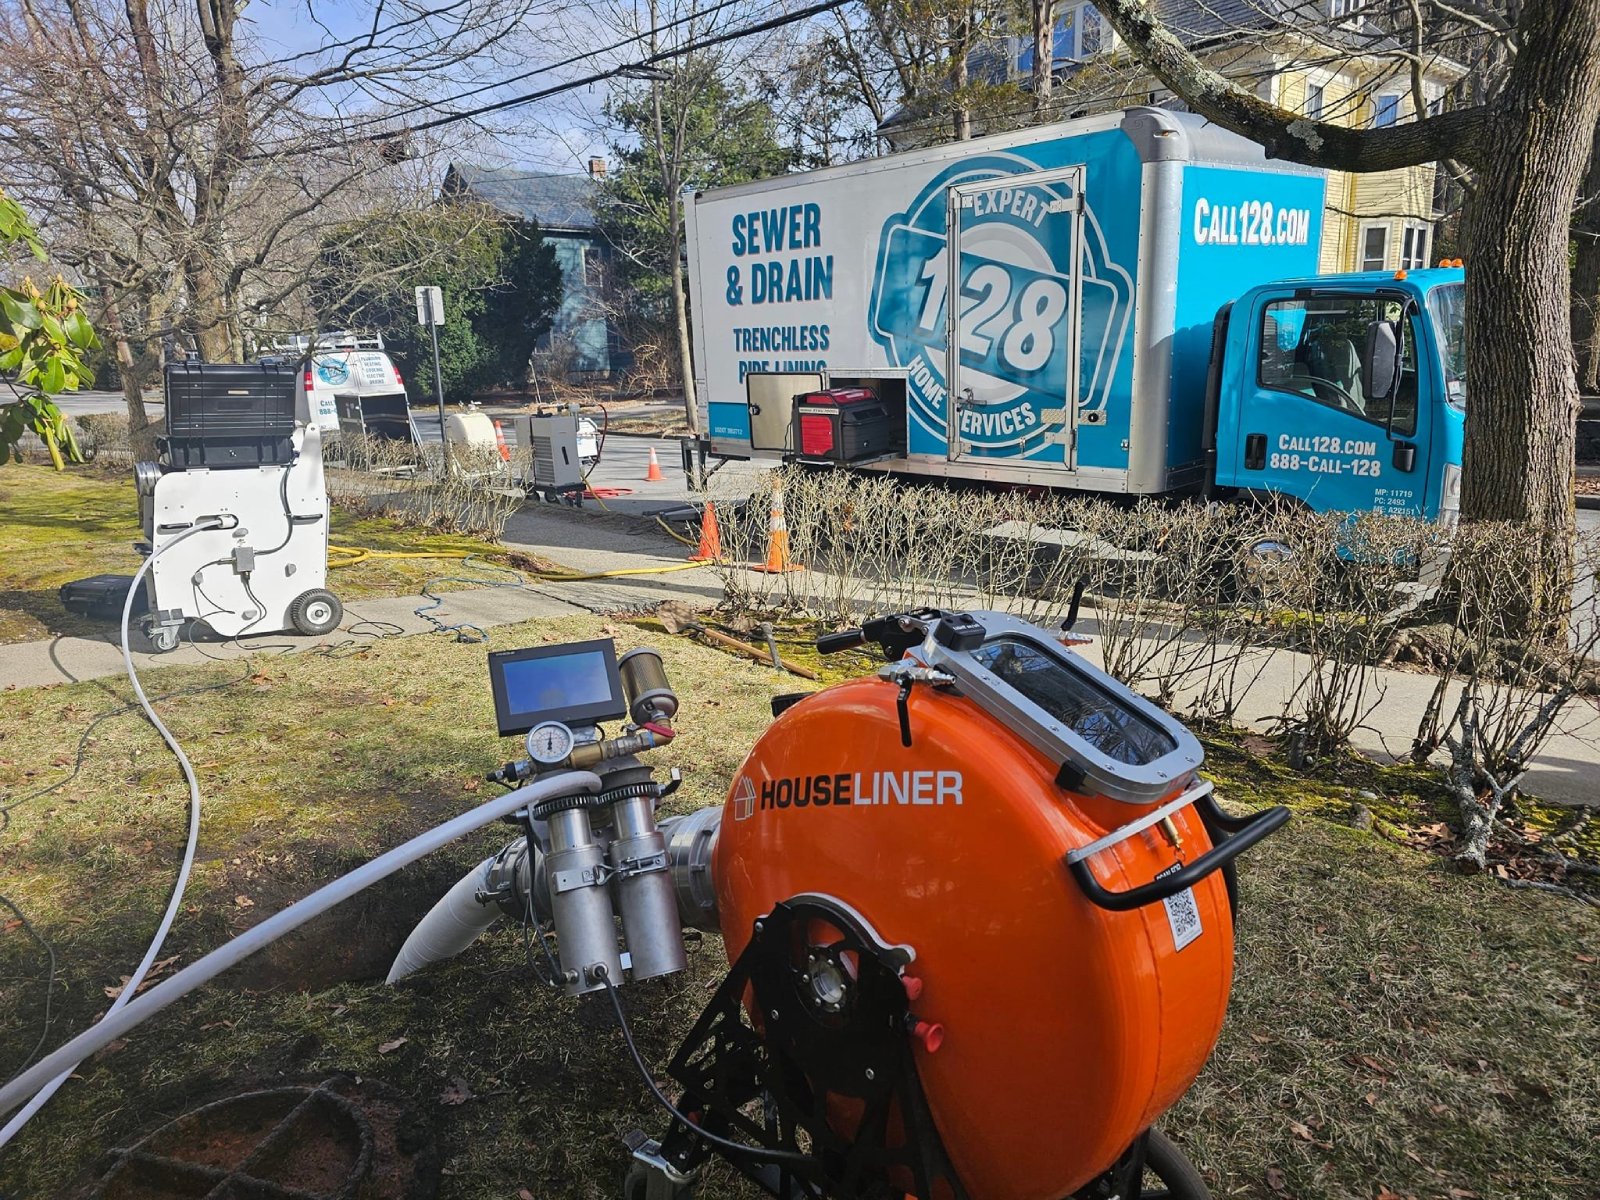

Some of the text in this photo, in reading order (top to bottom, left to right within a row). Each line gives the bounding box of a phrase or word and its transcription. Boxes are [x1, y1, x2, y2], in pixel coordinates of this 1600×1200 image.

[973, 188, 1051, 228] EXPERT
[732, 202, 821, 257] SEWER
[726, 255, 833, 306] & DRAIN
[920, 246, 1067, 371] 128
[733, 325, 830, 352] TRENCHLESS
[907, 354, 1037, 437] HOME ERVICES
[1270, 453, 1381, 477] 888-CALL-128
[1279, 434, 1376, 456] CALL128.COM
[1374, 497, 1406, 506] PC: 2493
[1375, 488, 1413, 498] MP: 11719
[760, 770, 963, 810] HOUSELINER
